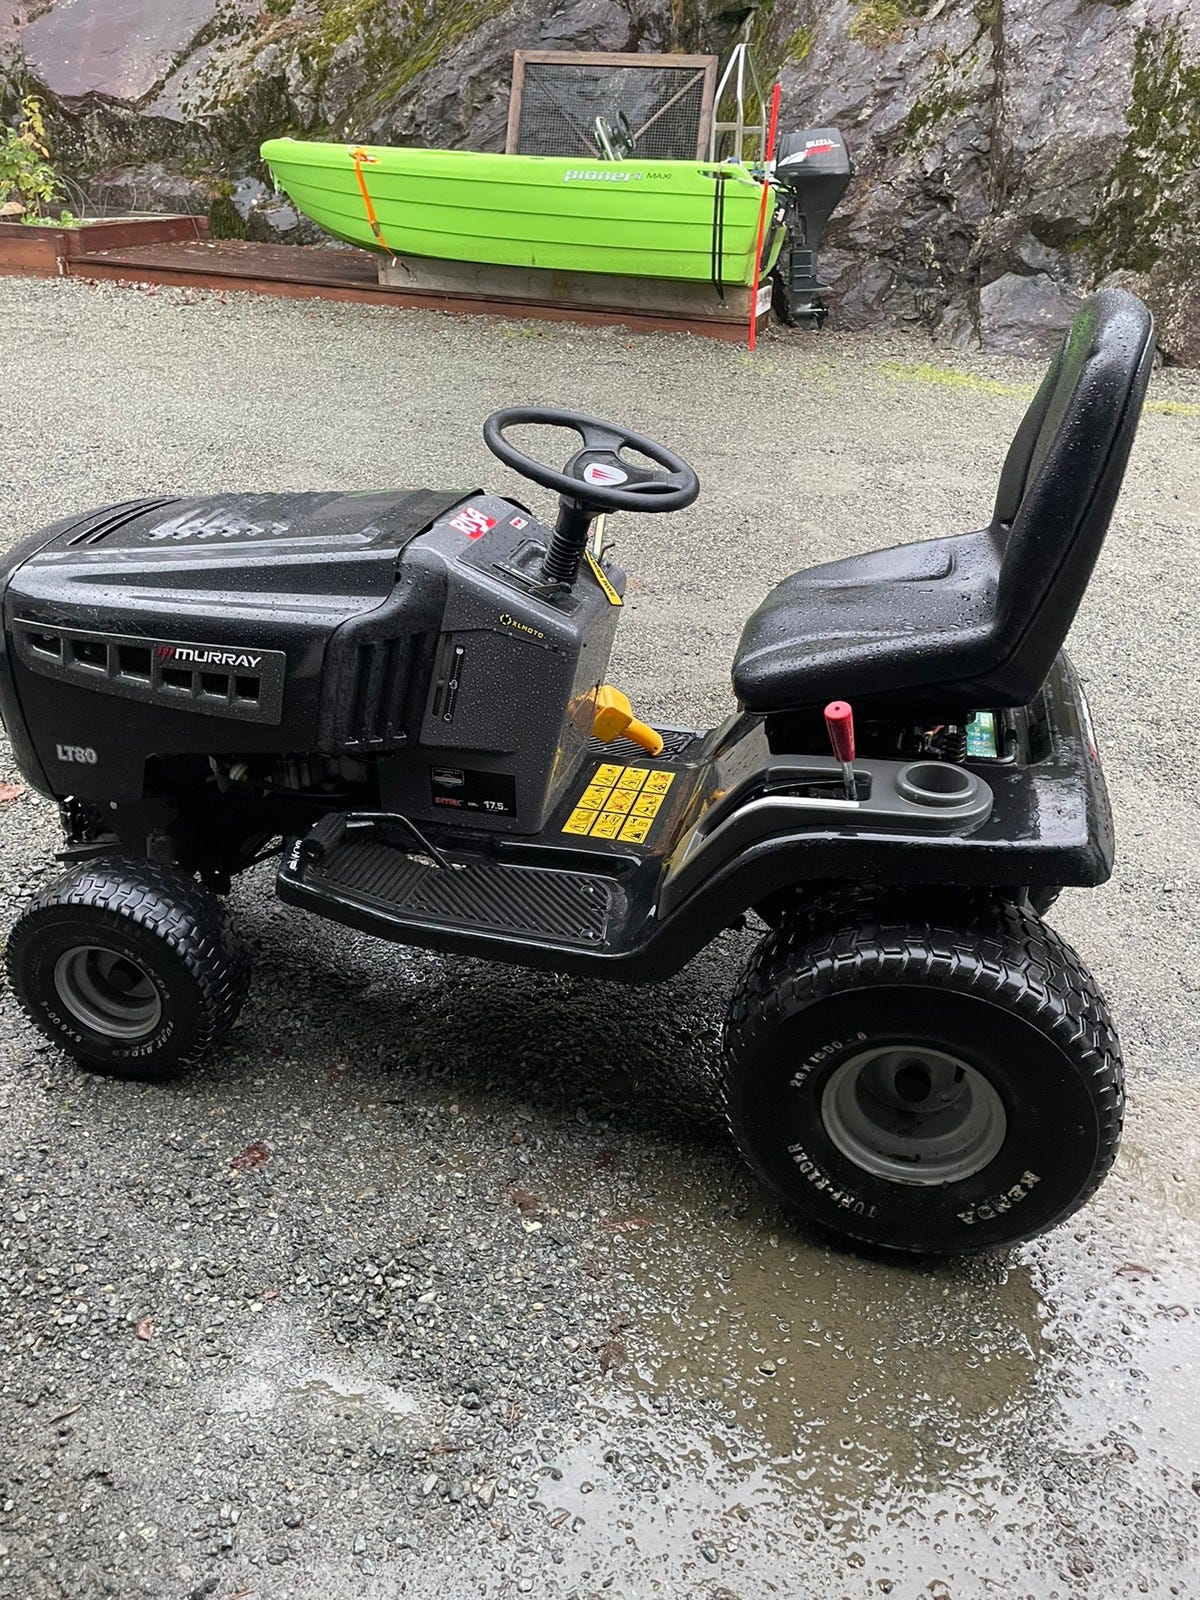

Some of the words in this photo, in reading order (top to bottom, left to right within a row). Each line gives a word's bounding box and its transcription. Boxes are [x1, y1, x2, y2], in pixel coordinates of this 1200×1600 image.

[564, 169, 632, 183] pioner
[646, 172, 672, 180] MAXI
[511, 620, 545, 639] XLMOTO
[175, 648, 262, 668] MURRAY
[55, 744, 98, 764] LT80
[483, 801, 505, 811] 17.5
